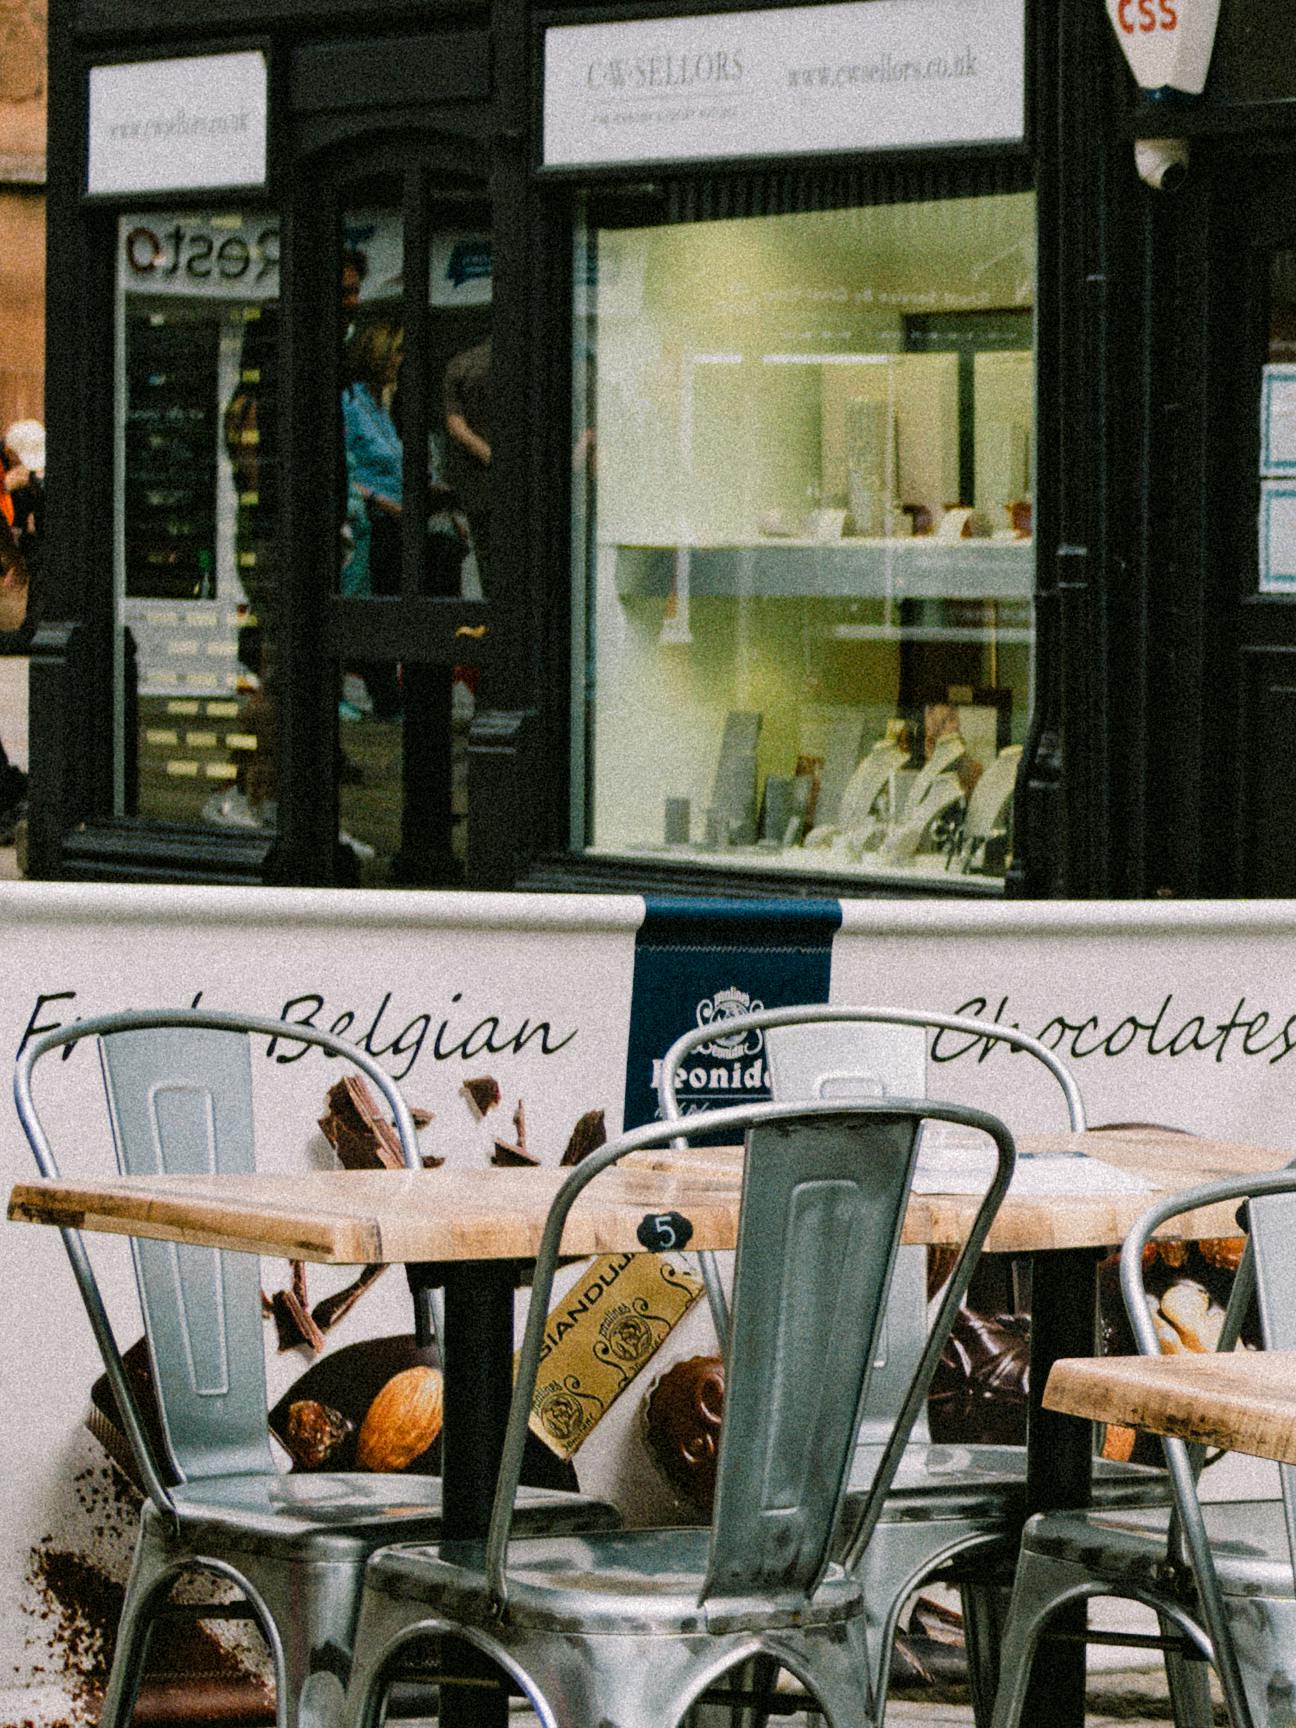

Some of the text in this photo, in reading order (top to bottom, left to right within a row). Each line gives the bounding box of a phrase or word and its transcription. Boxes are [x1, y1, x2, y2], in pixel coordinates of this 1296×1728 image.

[265, 990, 579, 1083] Belgian
[654, 1215, 677, 1248] 5
[538, 1253, 637, 1363] GIANDUJ
